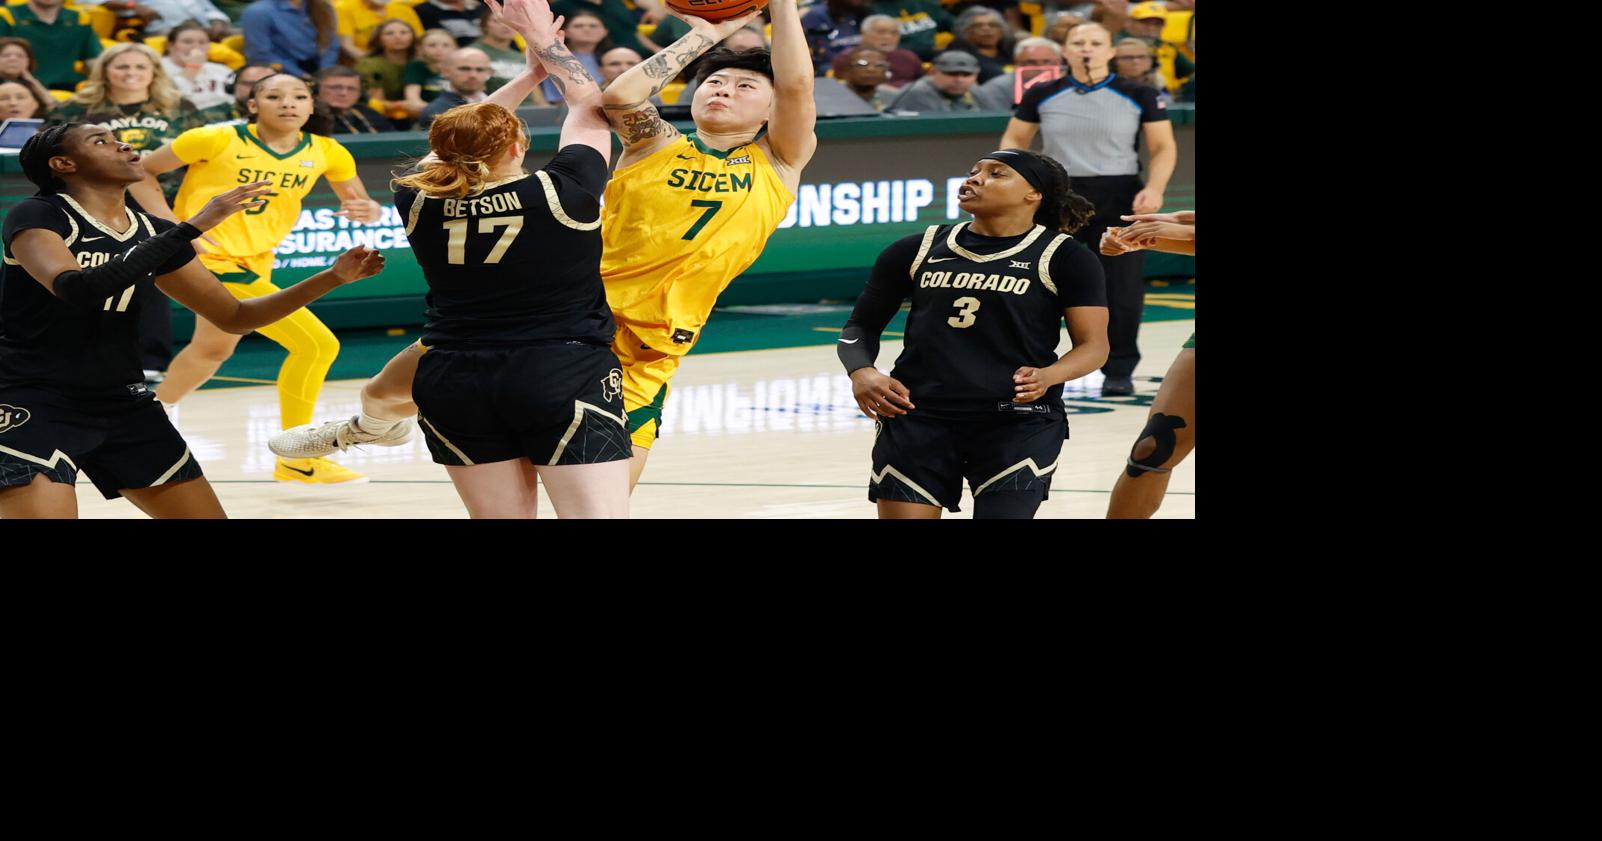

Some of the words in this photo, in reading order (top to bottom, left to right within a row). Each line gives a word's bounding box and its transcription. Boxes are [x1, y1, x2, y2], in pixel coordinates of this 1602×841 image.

[98, 117, 168, 132] AYLOR
[443, 191, 523, 217] BETSON
[780, 178, 934, 228] NSHIP
[681, 199, 723, 240] 7
[272, 227, 411, 254] SURANCE
[442, 215, 524, 265] 17
[920, 271, 1031, 295] COLORADO
[947, 296, 981, 329] 3
